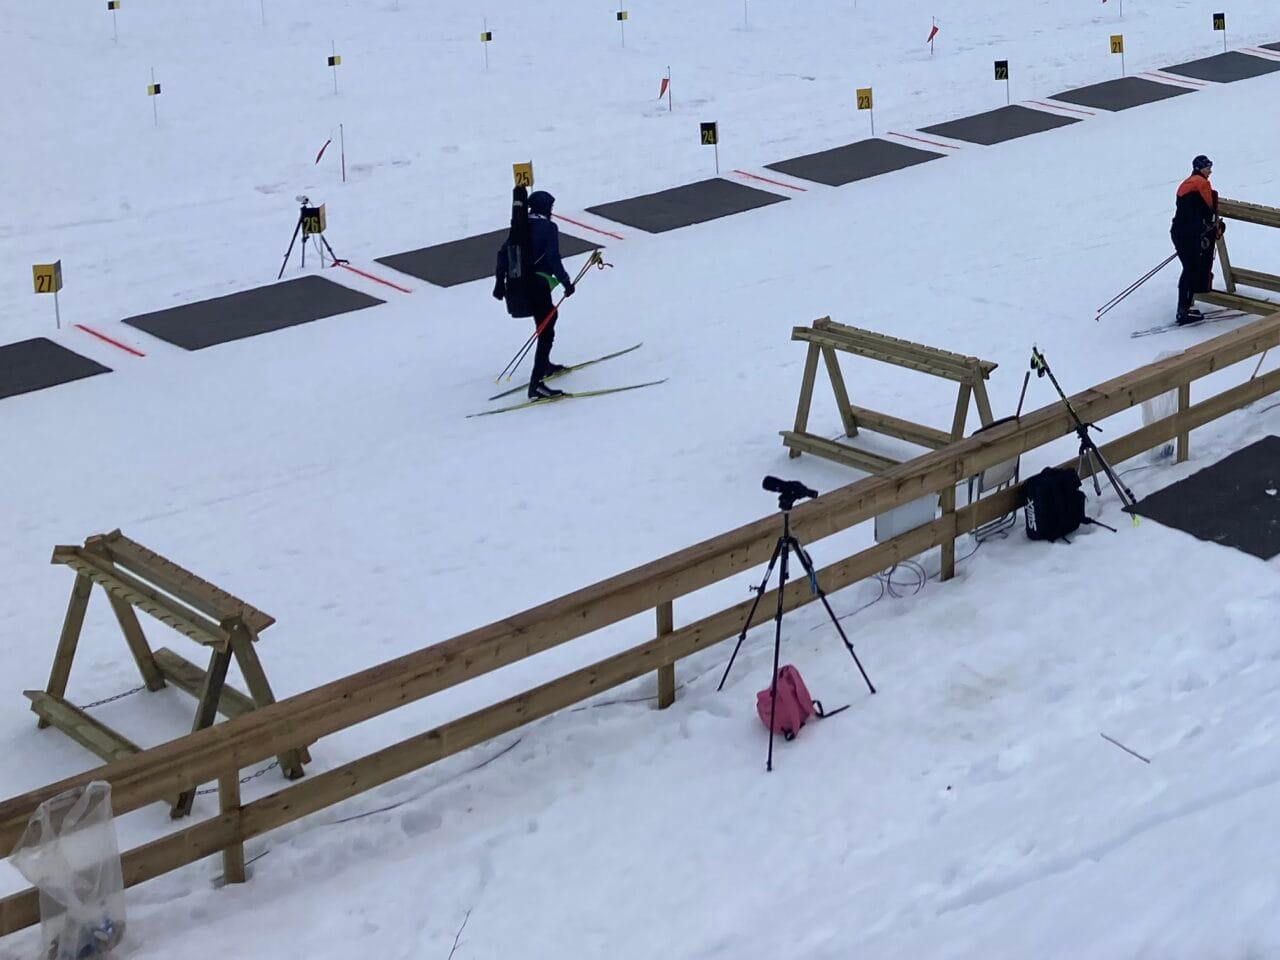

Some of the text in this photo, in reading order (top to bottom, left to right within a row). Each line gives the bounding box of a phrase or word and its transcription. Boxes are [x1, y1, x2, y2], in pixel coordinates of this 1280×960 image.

[1112, 41, 1121, 53] 21
[996, 67, 1007, 79] 22
[859, 96, 870, 110] 23
[703, 131, 714, 144] 24
[516, 171, 530, 187] 25
[304, 216, 319, 233] 26
[37, 275, 52, 292] 27
